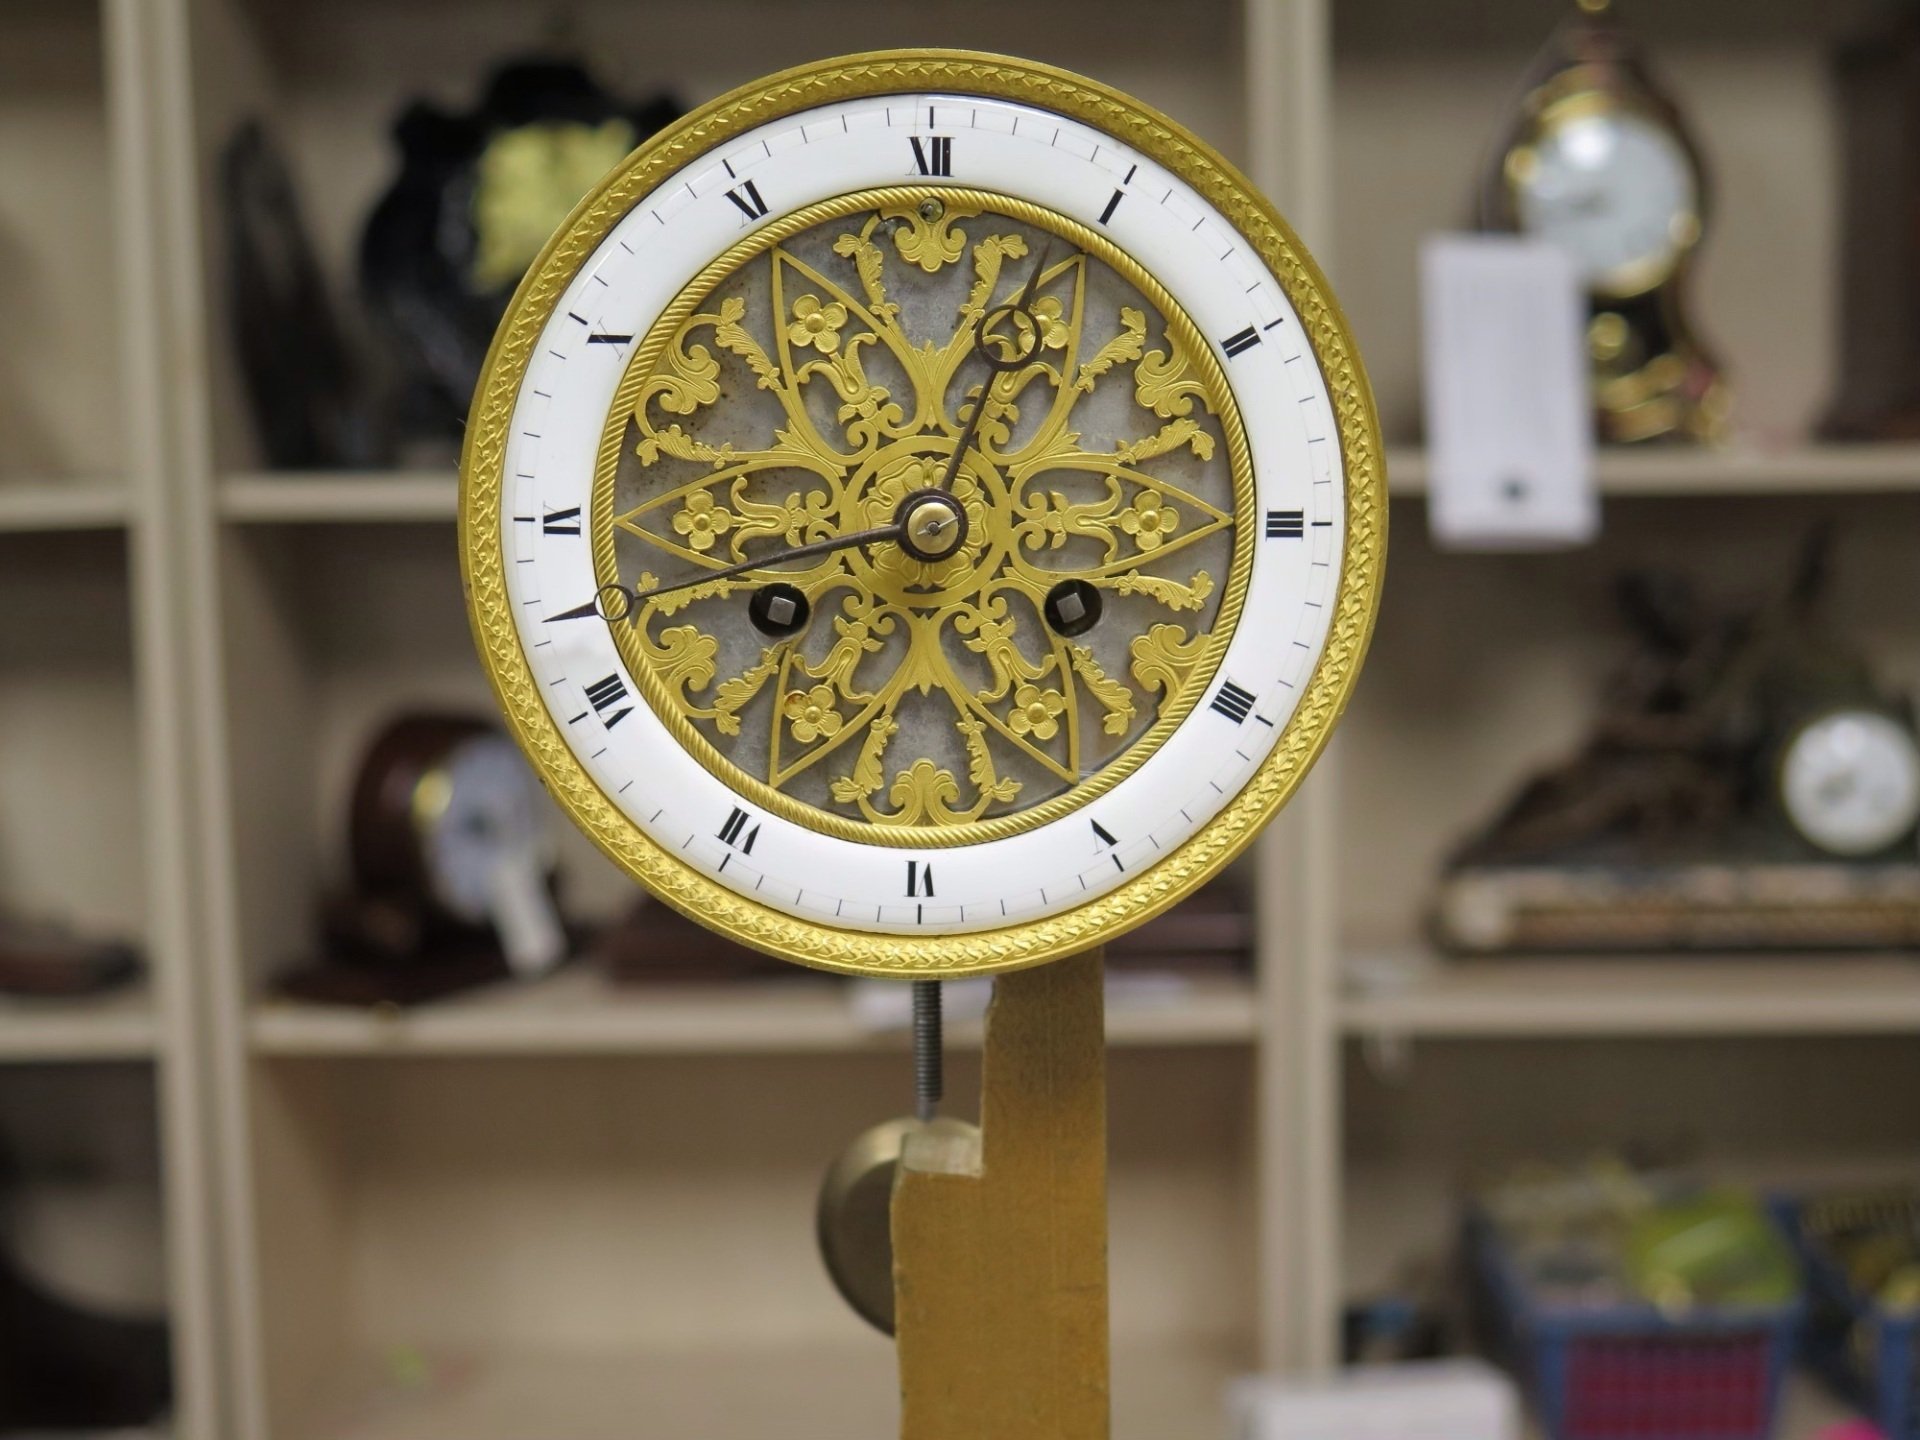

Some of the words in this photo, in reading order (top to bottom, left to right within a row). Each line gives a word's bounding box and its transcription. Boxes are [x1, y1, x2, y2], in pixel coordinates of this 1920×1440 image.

[905, 137, 955, 176] XII
[723, 178, 773, 228] XI
[1096, 188, 1127, 226] I
[586, 317, 636, 362] X
[1219, 322, 1263, 361] II
[543, 501, 581, 538] IX
[1266, 507, 1304, 541] III
[582, 670, 635, 731] VIII
[714, 805, 761, 856] VII
[1090, 818, 1122, 855] V
[904, 861, 935, 897] VI
